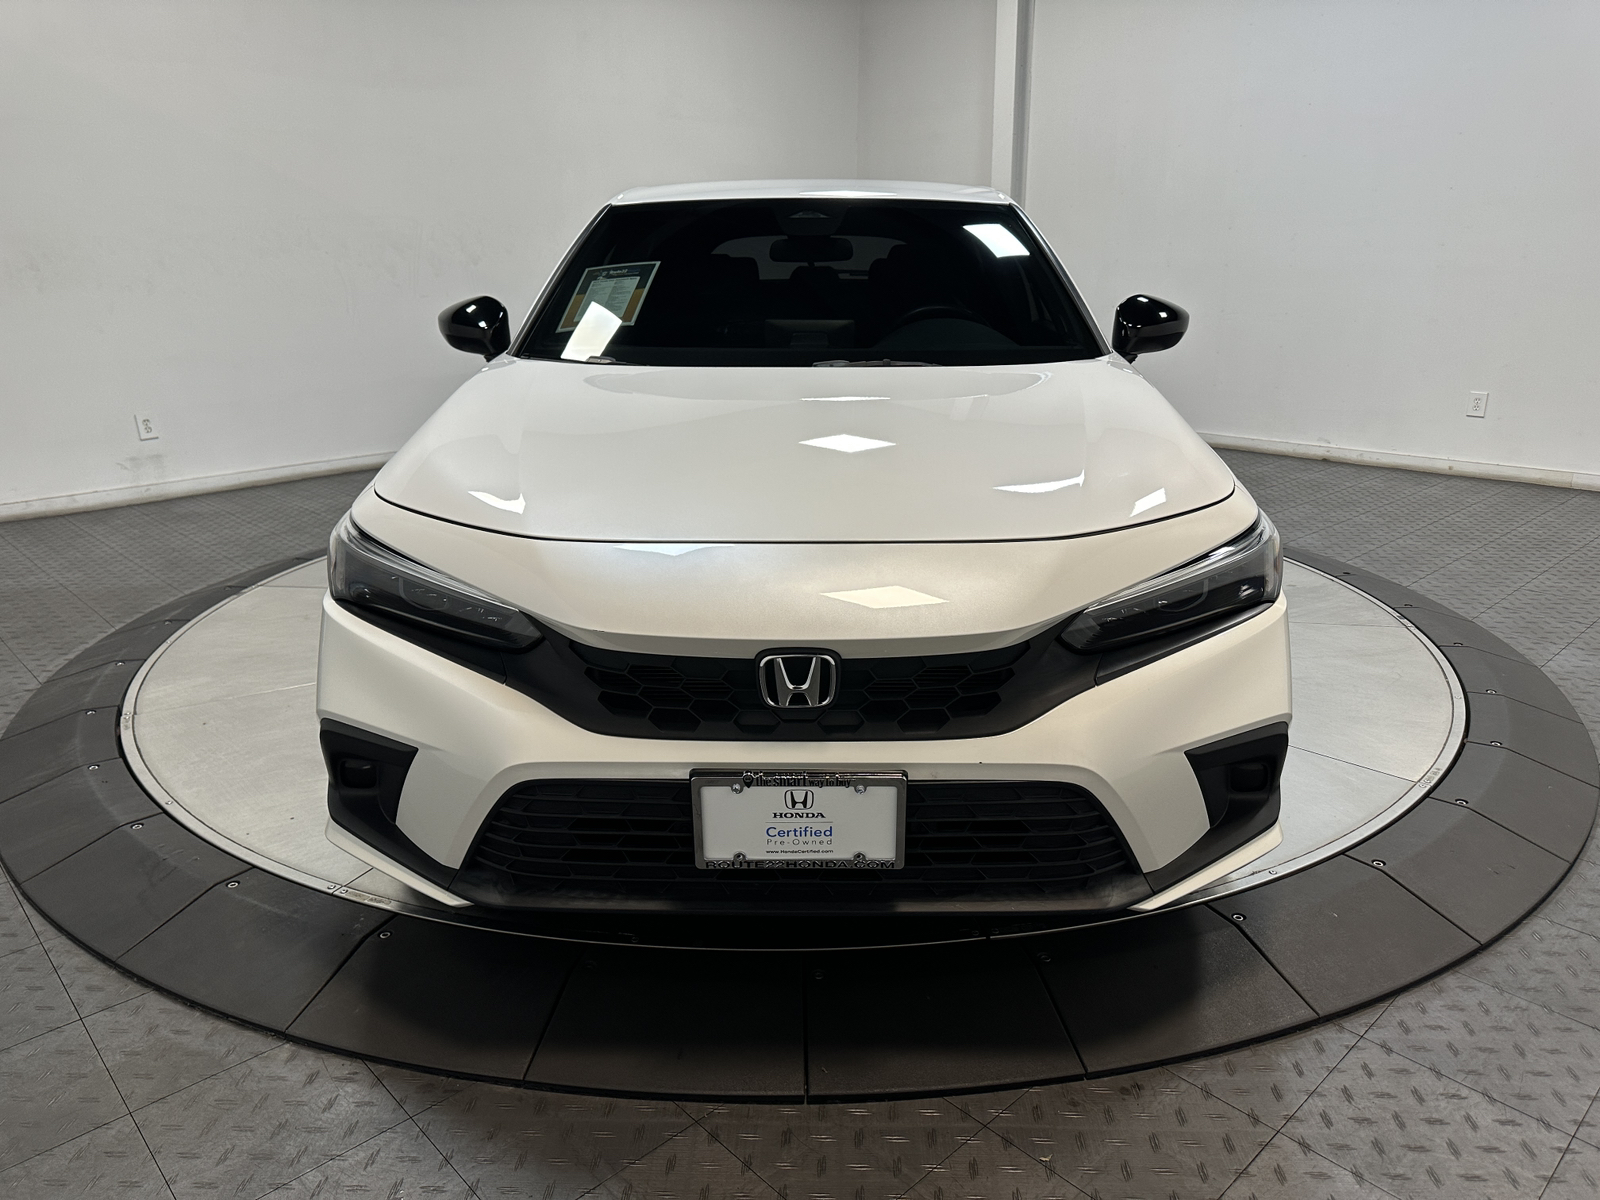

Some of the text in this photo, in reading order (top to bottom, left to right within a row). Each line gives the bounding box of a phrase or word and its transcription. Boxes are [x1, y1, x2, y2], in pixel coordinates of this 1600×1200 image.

[756, 772, 851, 788] the smart way to buy
[766, 826, 833, 838] Certified
